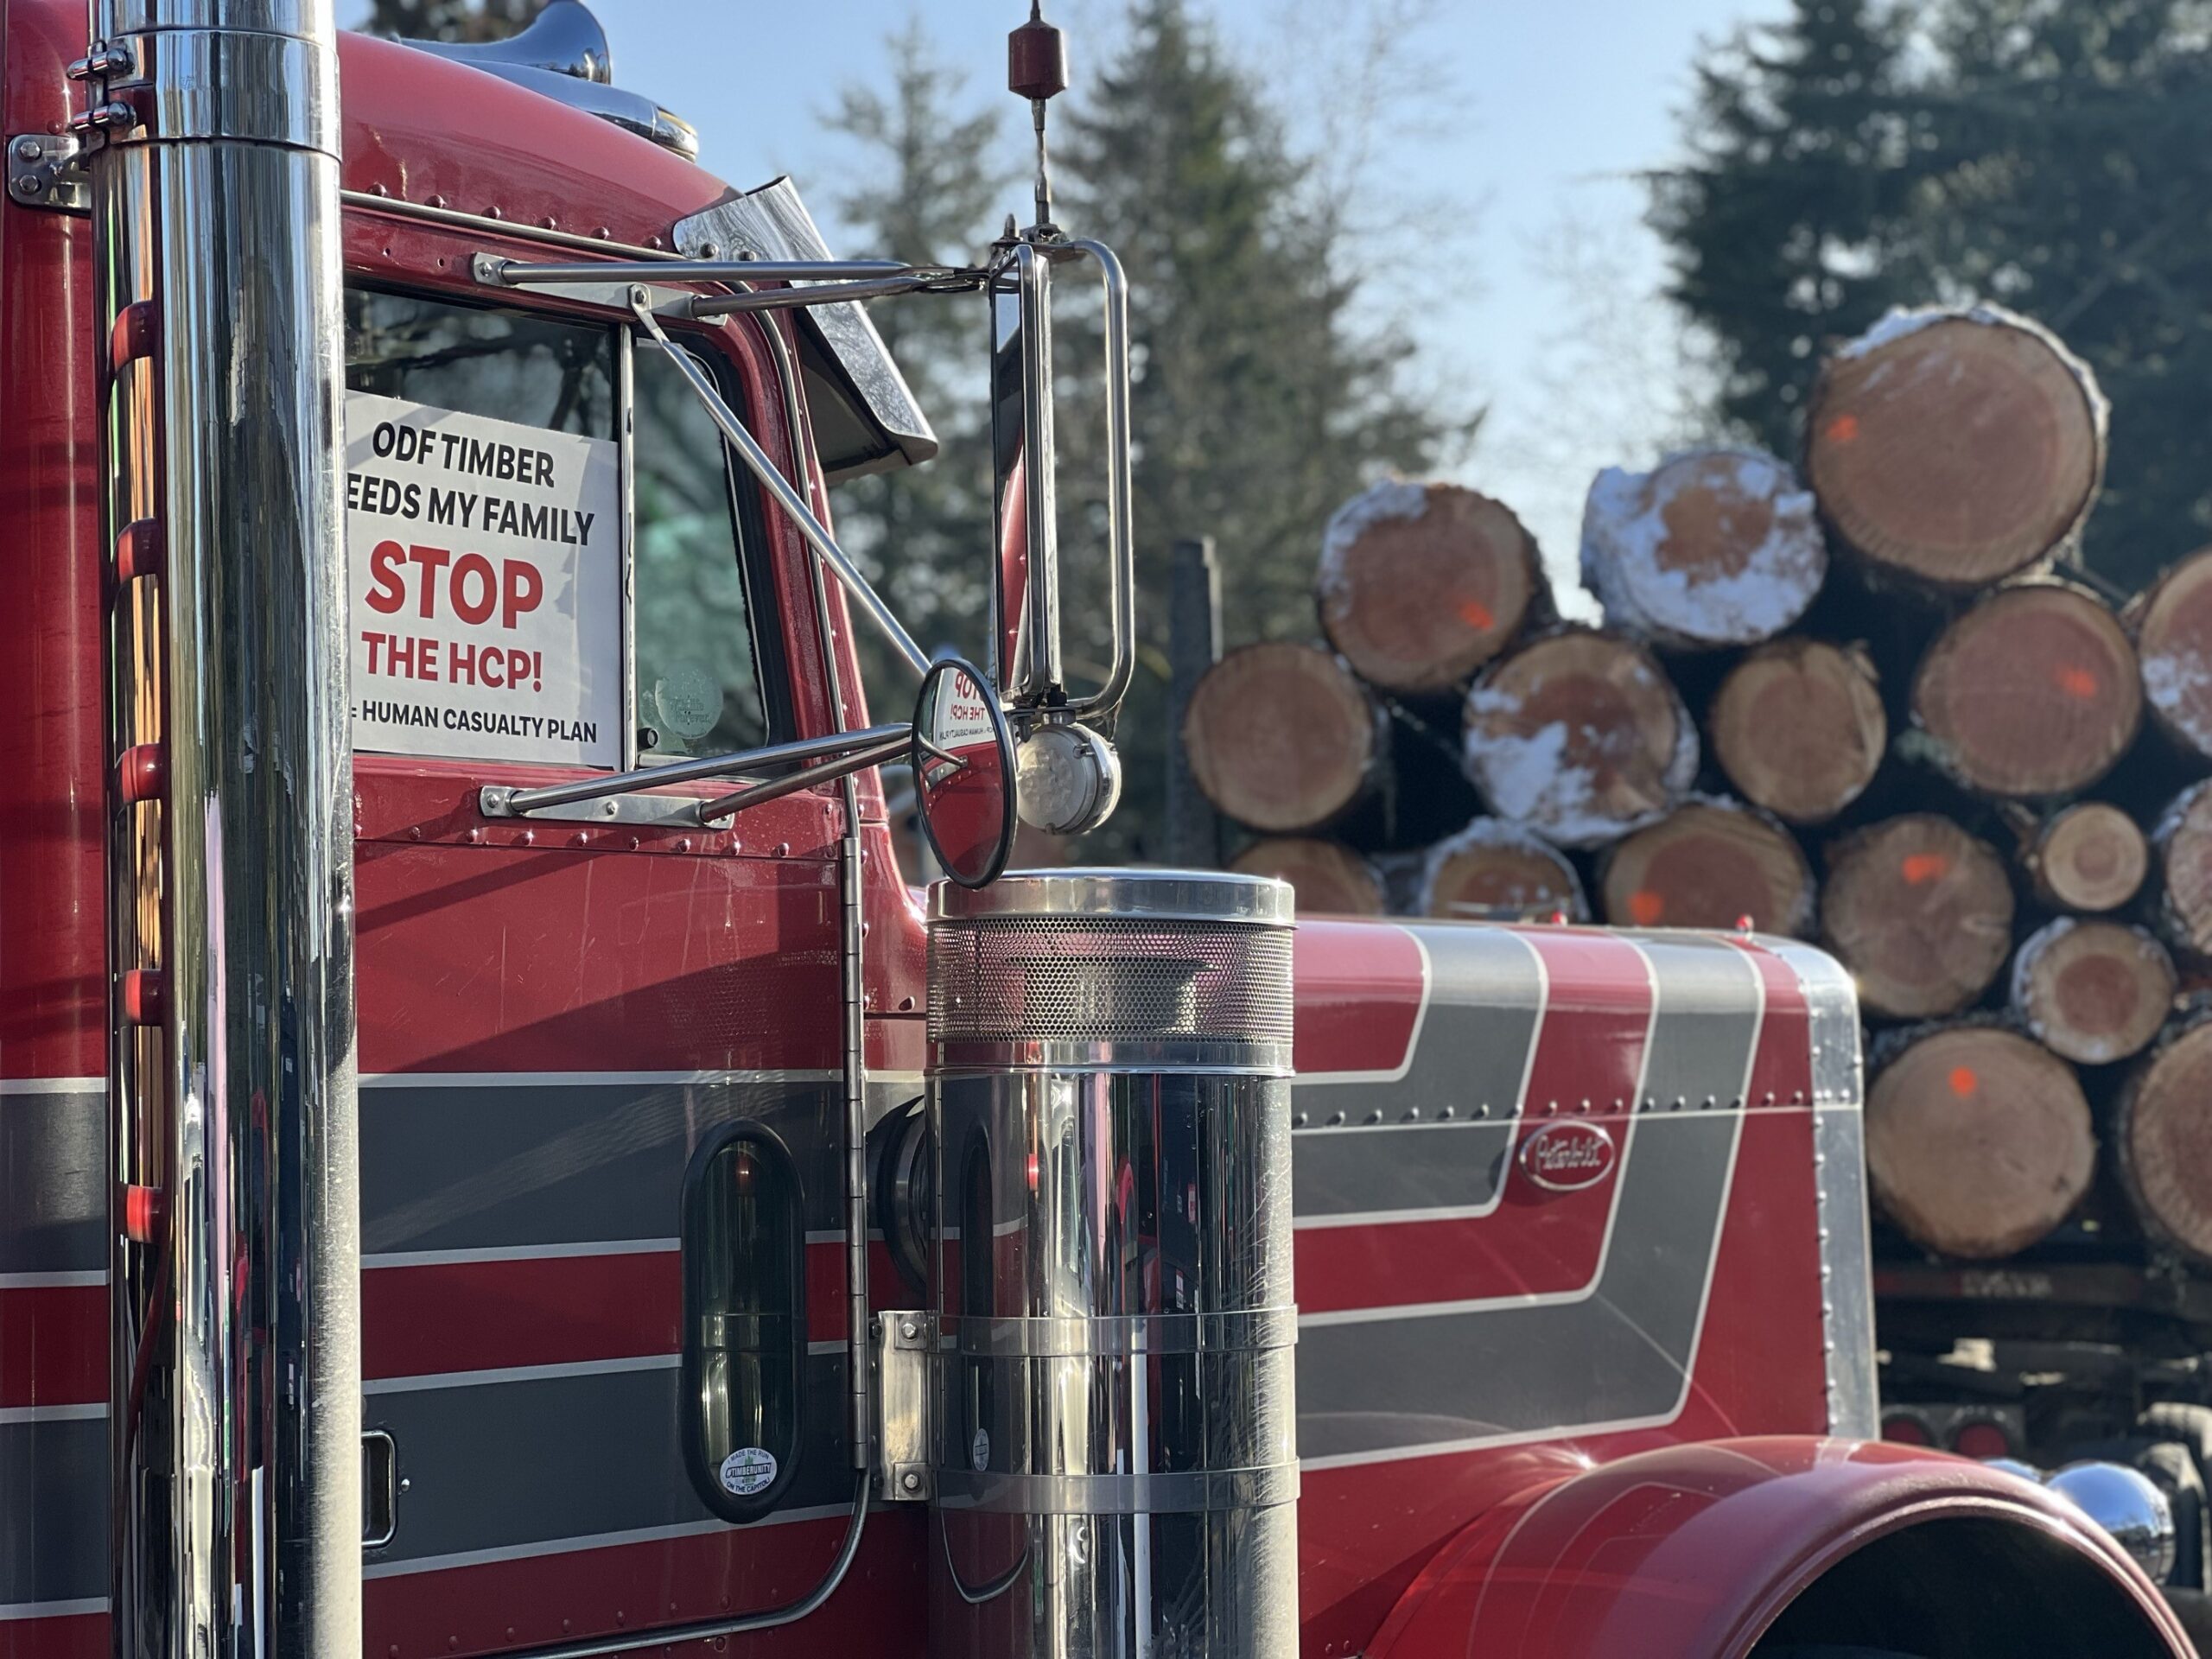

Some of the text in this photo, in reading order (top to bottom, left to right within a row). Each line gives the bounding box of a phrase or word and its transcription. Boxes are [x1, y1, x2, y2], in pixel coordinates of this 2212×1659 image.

[372, 422, 555, 488] ODF TIMBER
[347, 473, 595, 546] EEDS MY FAMILY
[364, 540, 543, 630] STOP
[361, 631, 542, 692] THE HCP!
[362, 700, 438, 728] HUMAN
[443, 709, 543, 738] CASUALTY
[548, 719, 597, 743] PLAN
[727, 1481, 734, 1490] ON
[731, 1450, 746, 1460] MADE
[758, 1450, 769, 1459] RUN
